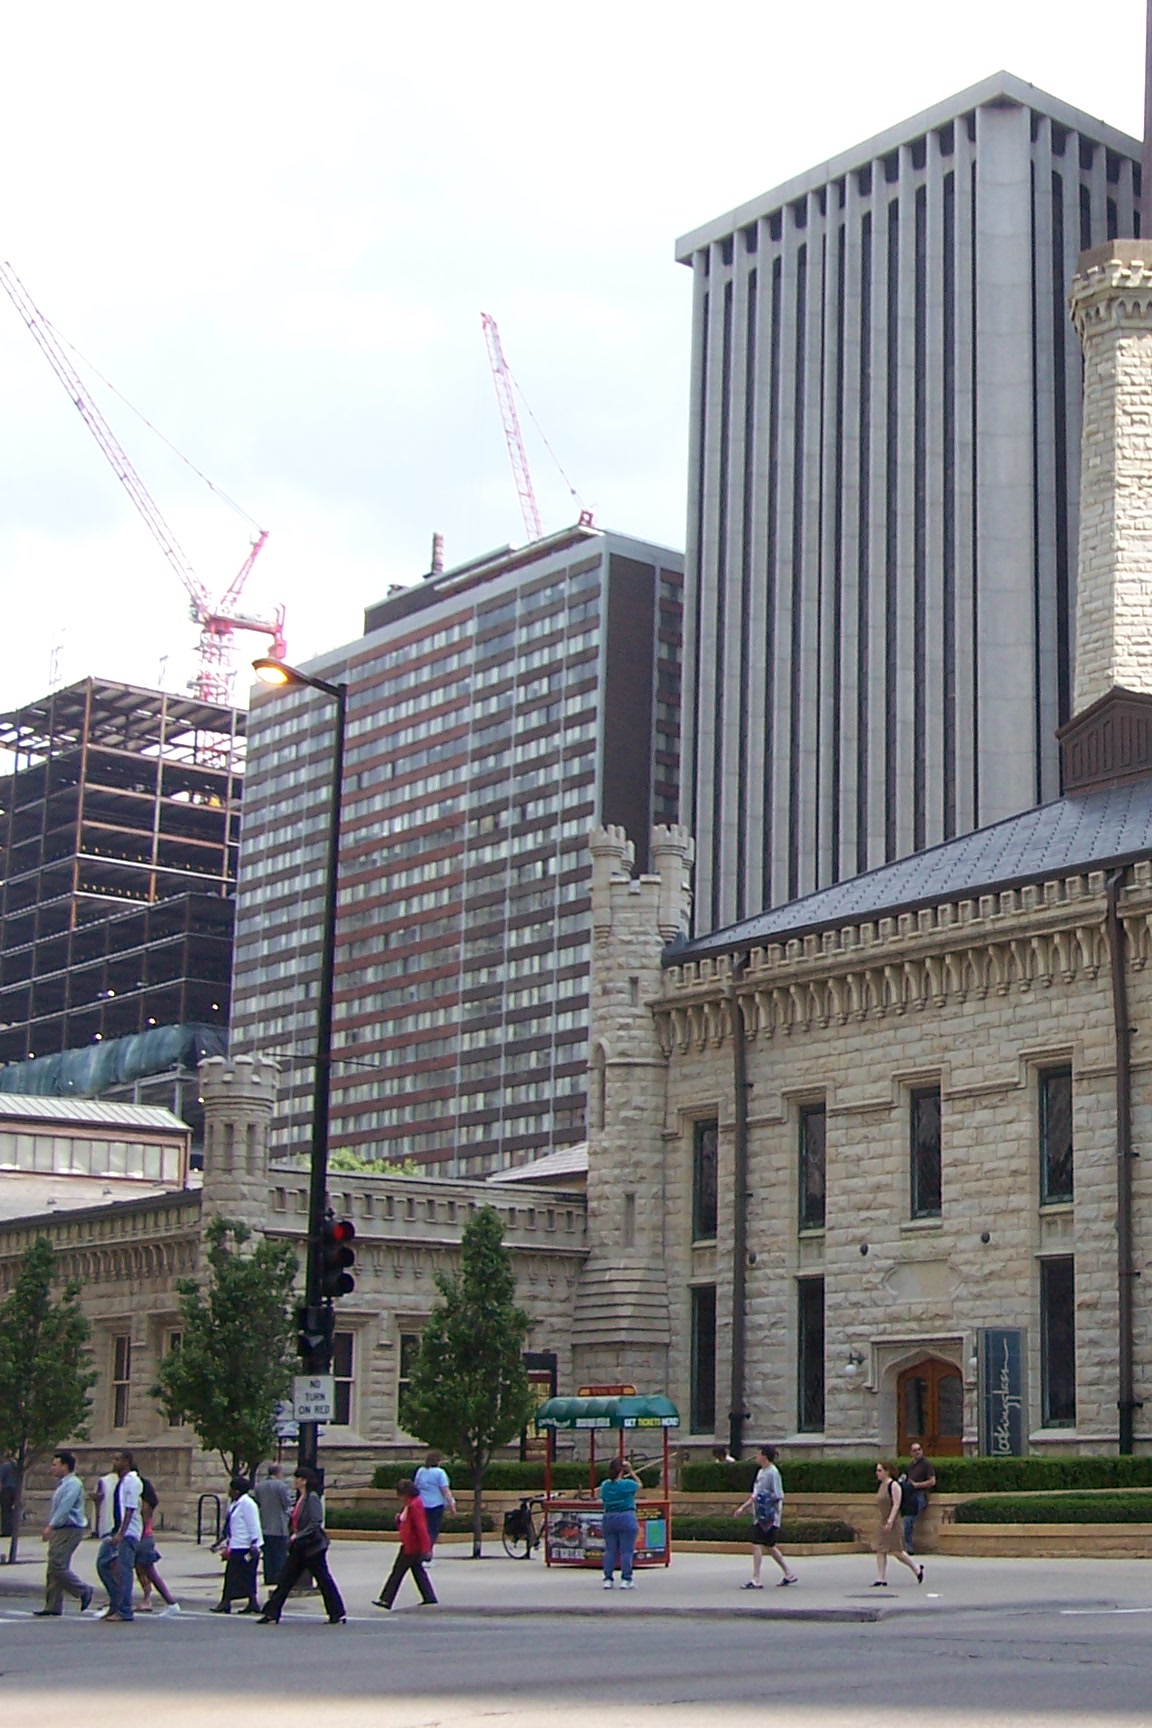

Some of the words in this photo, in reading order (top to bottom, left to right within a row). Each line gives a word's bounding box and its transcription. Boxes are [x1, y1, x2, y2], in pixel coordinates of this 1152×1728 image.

[310, 1380, 321, 1388] NO
[305, 1392, 326, 1401] TURN
[299, 1405, 311, 1414] ON
[314, 1405, 330, 1414] RED
